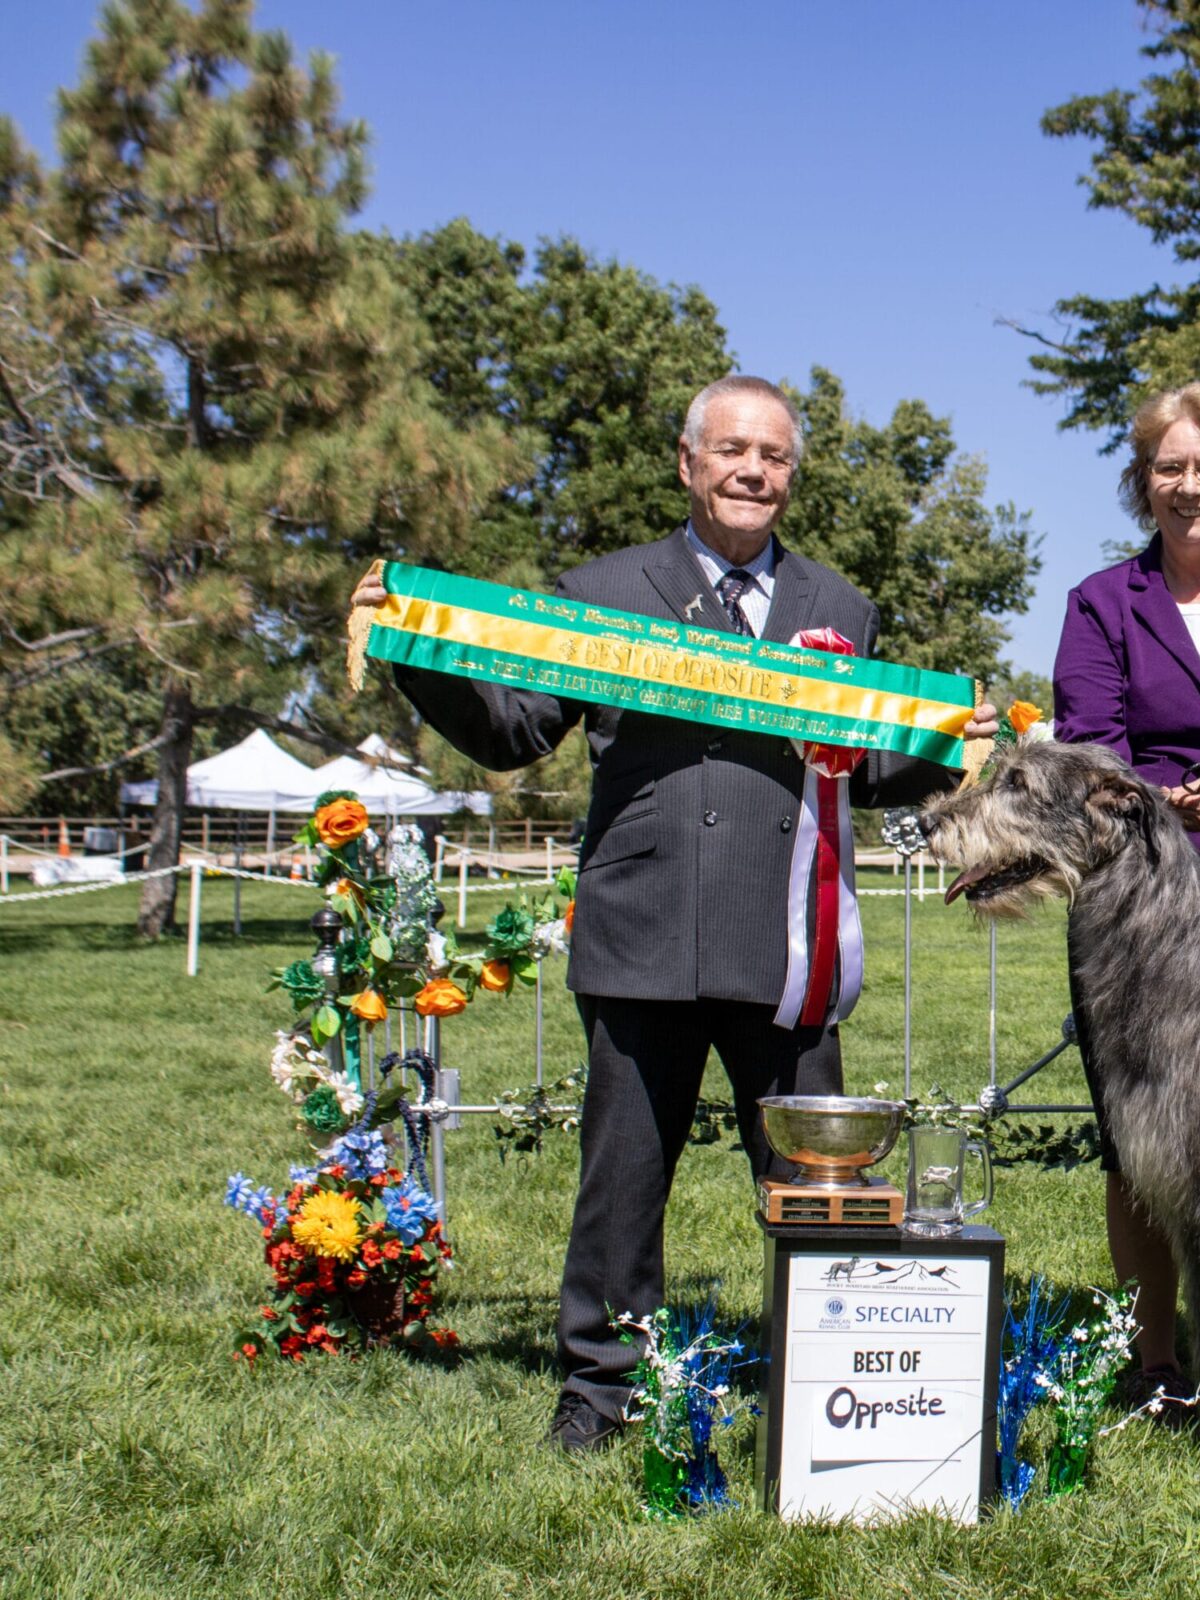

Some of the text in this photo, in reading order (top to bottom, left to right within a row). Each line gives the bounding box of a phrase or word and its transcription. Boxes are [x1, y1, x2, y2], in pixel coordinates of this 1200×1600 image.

[535, 599, 578, 622] Rocky
[583, 608, 645, 634] Mountain
[687, 630, 753, 655] Wolfhound
[757, 645, 828, 670] Association
[583, 636, 636, 673] BEST
[643, 651, 670, 679] OF
[673, 656, 773, 700] OPPOSITE
[711, 702, 744, 721] IRISH
[748, 708, 829, 736] WOLFHOUNDS
[855, 1306, 956, 1323] SPECIALTY
[853, 1350, 922, 1373] BEST OF
[825, 1386, 947, 1430] Opposite
